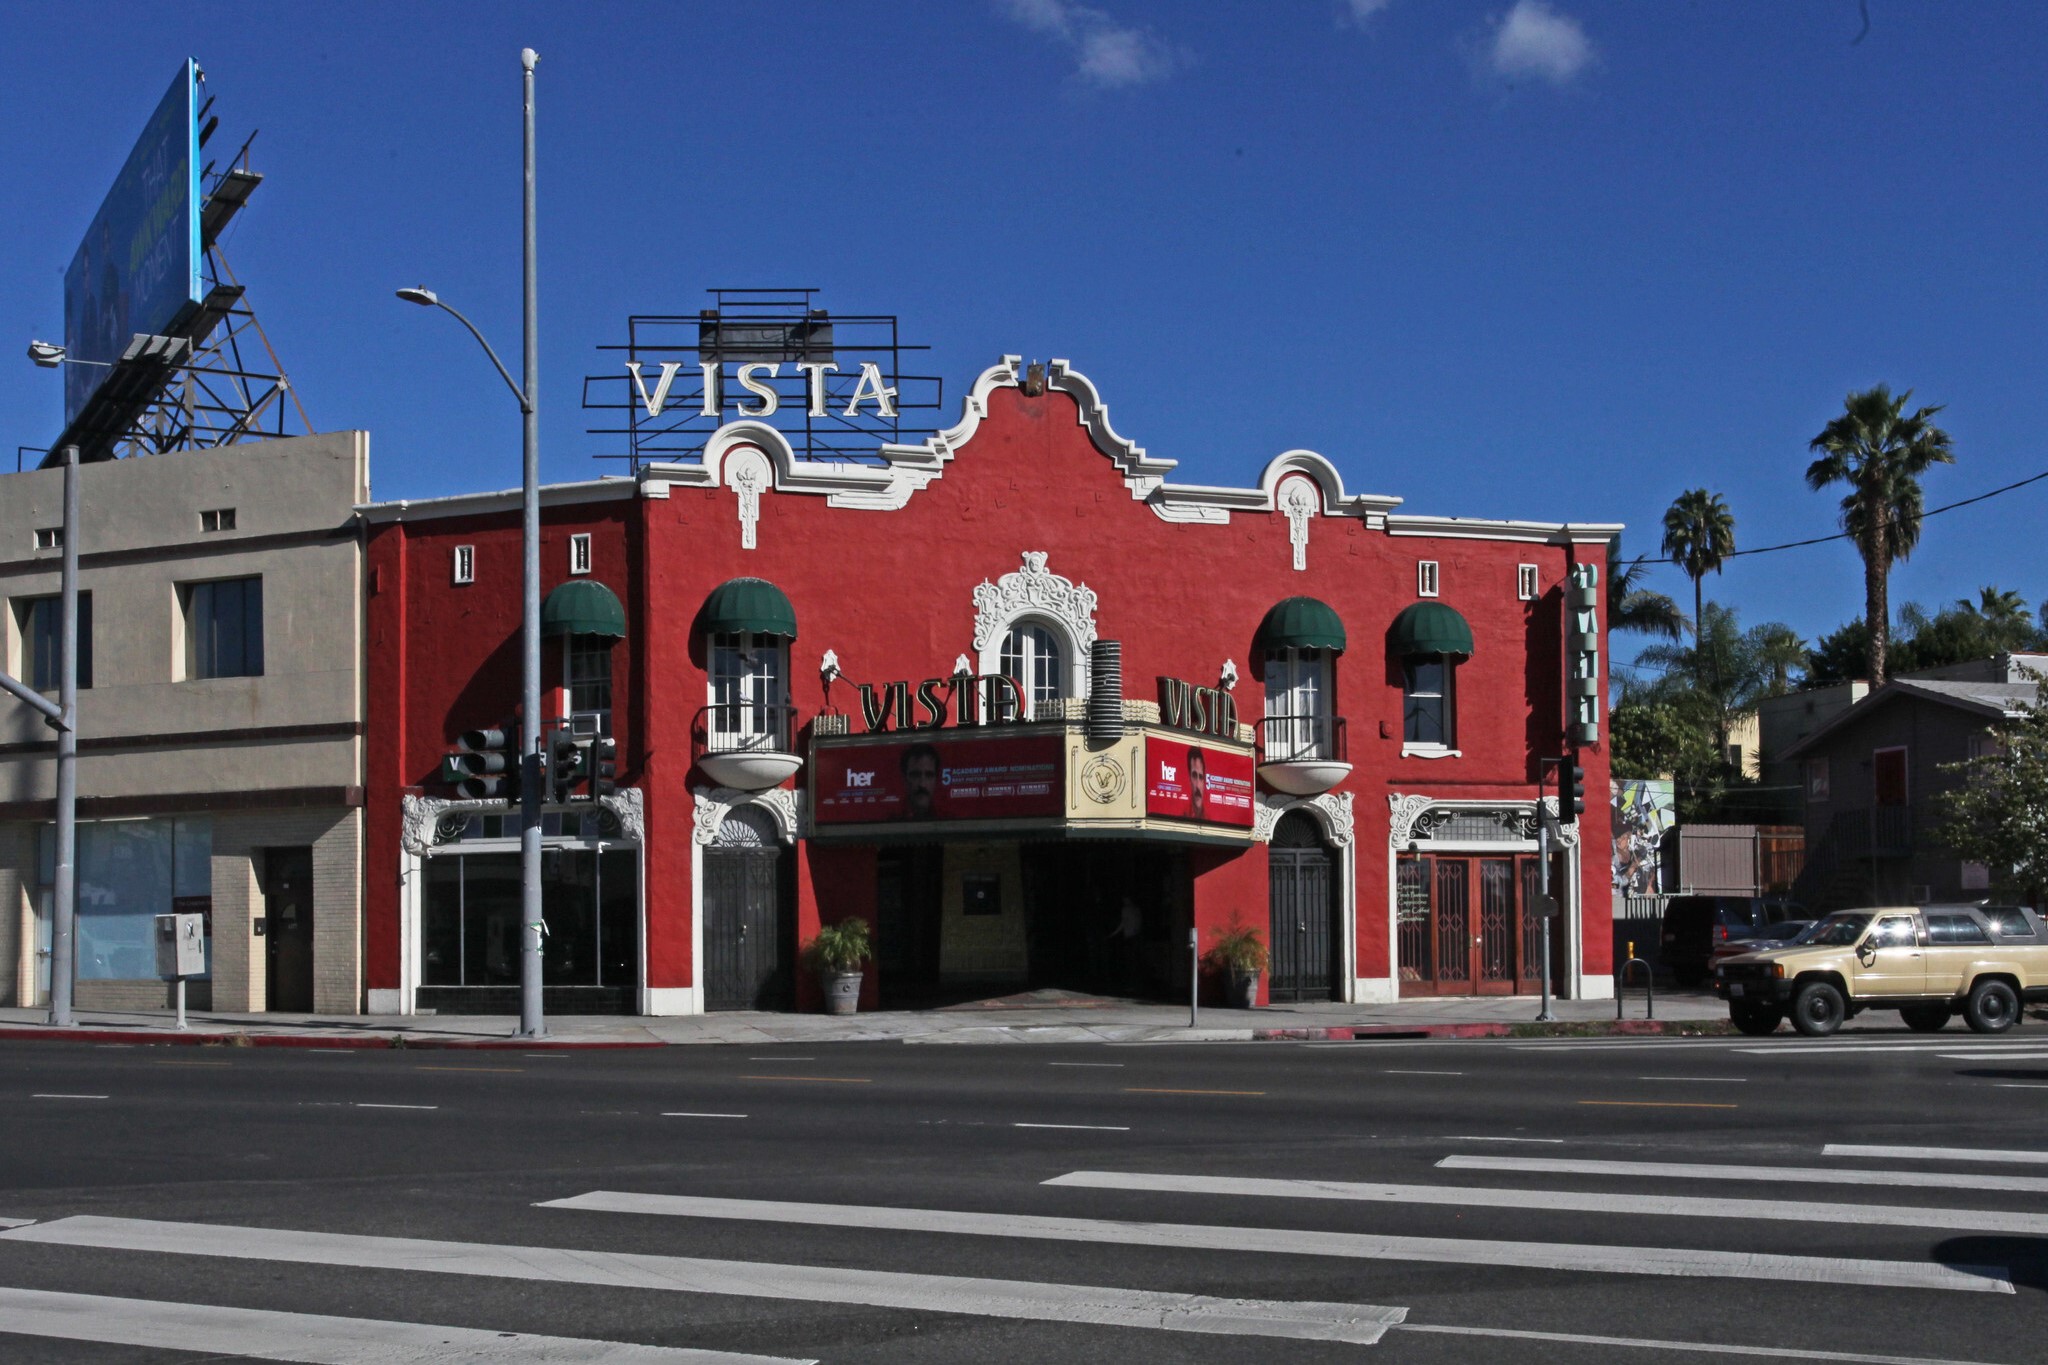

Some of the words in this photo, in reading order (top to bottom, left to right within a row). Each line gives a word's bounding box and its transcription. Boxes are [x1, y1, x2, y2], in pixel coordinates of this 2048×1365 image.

[624, 360, 901, 418] VISTA
[857, 673, 1026, 733] VISTA
[1162, 677, 1241, 740] VISTA
[846, 768, 875, 787] her
[941, 768, 952, 785] 5
[952, 767, 983, 775] ACADEMY
[1161, 760, 1177, 782] her
